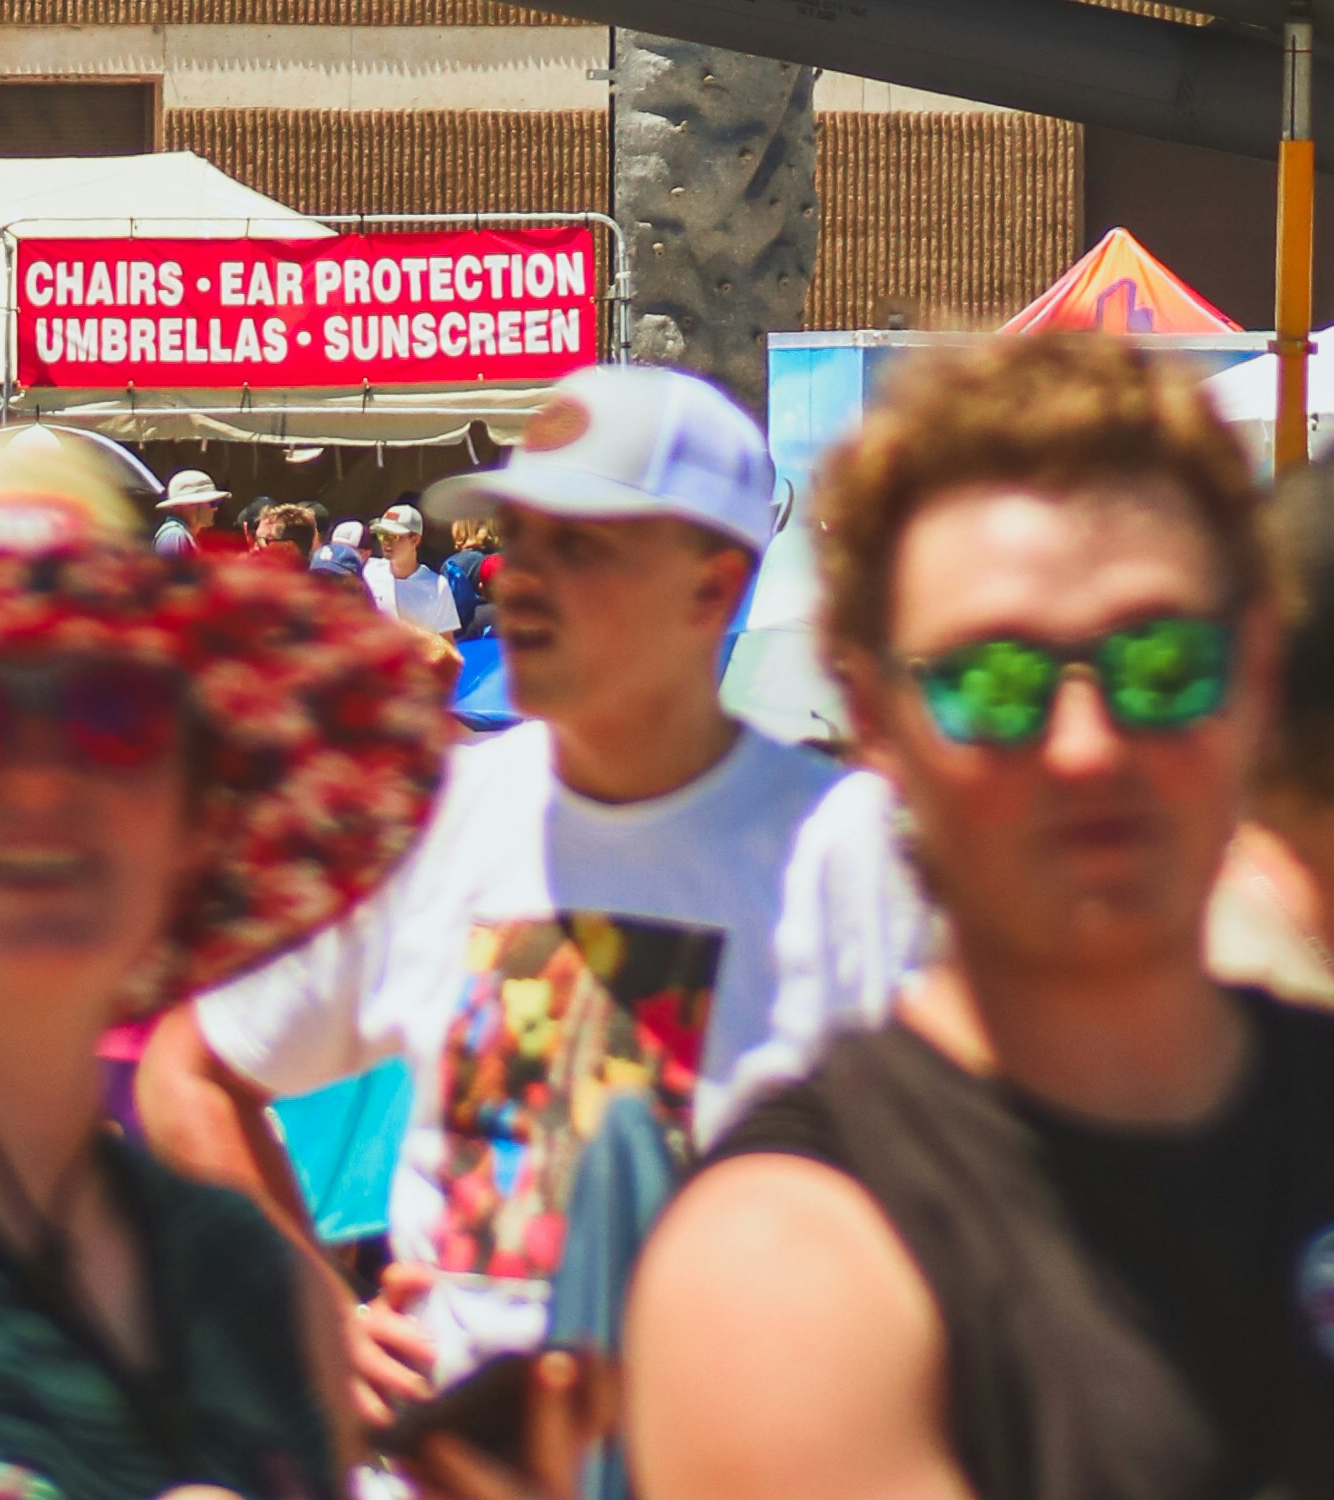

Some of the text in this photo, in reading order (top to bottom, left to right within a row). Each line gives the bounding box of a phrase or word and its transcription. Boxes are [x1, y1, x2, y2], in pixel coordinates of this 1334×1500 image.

[25, 251, 586, 307] CHAIRS EAR PROTECTION
[36, 308, 581, 364] UMBRELLAS SUNSCREEN
